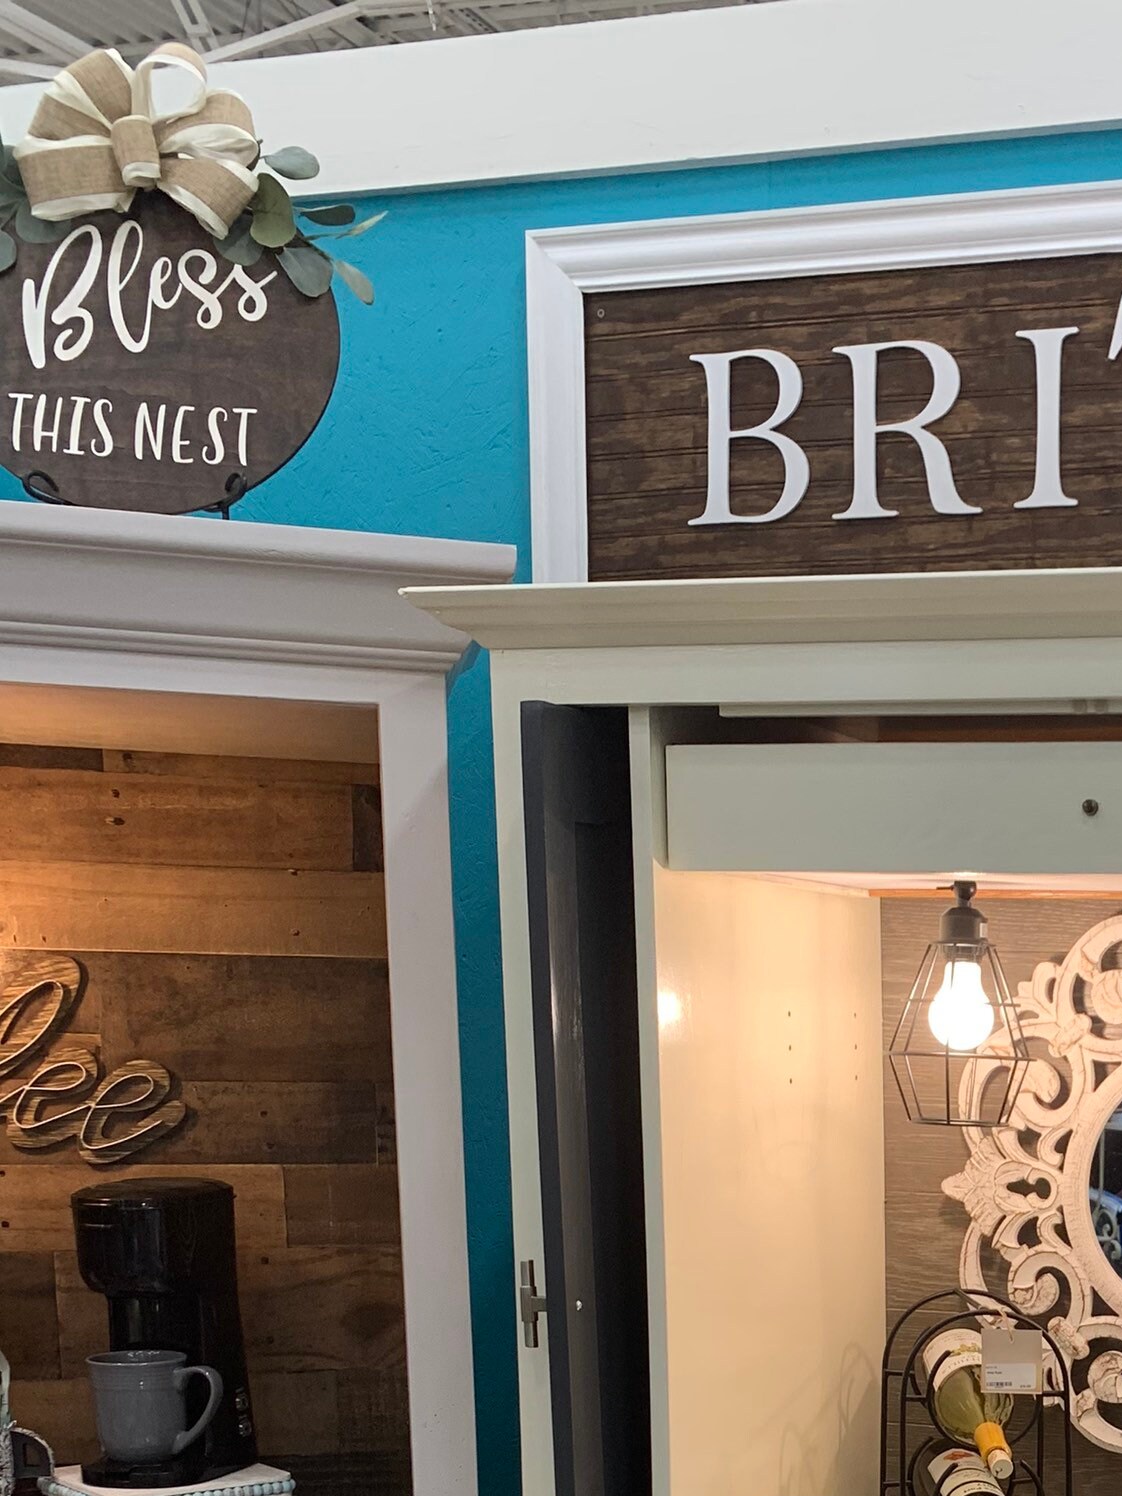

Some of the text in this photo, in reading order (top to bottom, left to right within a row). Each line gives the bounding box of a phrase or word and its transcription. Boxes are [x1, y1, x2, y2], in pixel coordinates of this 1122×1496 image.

[21, 219, 278, 369] Bless
[8, 391, 258, 467] THIS NEST
